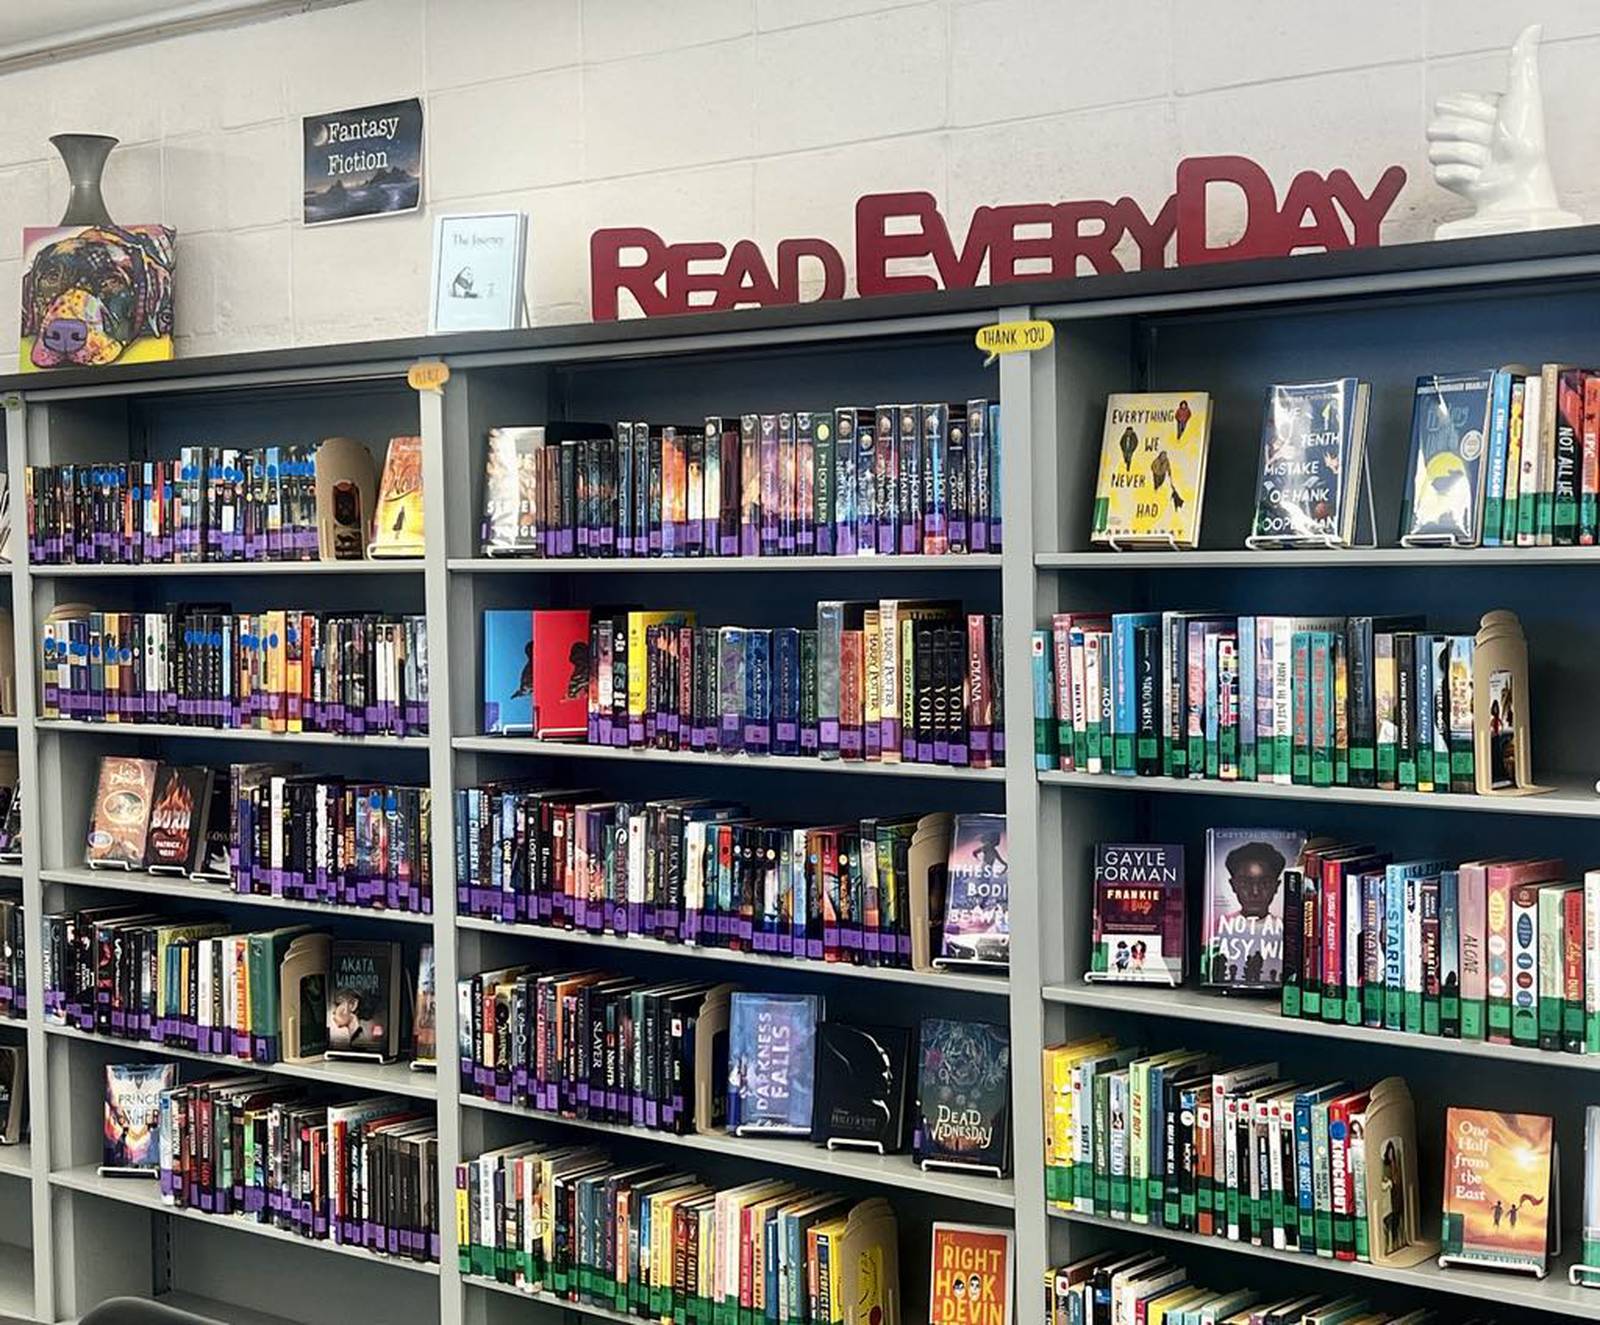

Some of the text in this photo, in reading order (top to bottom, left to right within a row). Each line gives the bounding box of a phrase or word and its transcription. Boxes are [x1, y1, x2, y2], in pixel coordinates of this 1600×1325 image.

[327, 116, 400, 144] Fantasy
[327, 150, 388, 176] Fiction
[590, 155, 1407, 322] READ EVERY DAY
[981, 324, 1046, 347] THANK YOU
[1112, 408, 1174, 424] EVERYTHING
[1144, 436, 1159, 452] WE
[1300, 432, 1339, 447] TENTH
[1559, 427, 1573, 453] NOT
[1263, 460, 1320, 476] MISTAKE
[1558, 456, 1573, 478] ALL
[1111, 473, 1146, 488] NEVER
[1291, 488, 1330, 502] HANK
[1136, 502, 1159, 518] HAD
[869, 633, 880, 711] HARRY POTTER
[884, 627, 895, 707] HARRY POTTER
[971, 660, 981, 702] DIANA
[919, 686, 931, 735] YORK
[934, 686, 946, 734] YORK
[949, 685, 961, 735] YORK
[1102, 687, 1111, 717] MOO
[1142, 676, 1152, 731] MOONRISE
[152, 810, 192, 829] BURN
[469, 820, 478, 870] CHILDREN
[1105, 851, 1166, 866] GAYLE
[1096, 866, 1176, 882] FORMAN
[1107, 889, 1160, 900] FRANKIE
[1218, 915, 1260, 935] NOT
[1210, 936, 1254, 959] EASY
[1367, 930, 1377, 962] NATE
[1427, 932, 1435, 976] FRANKIE
[1464, 934, 1479, 974] ALONE
[341, 958, 375, 974] AKATA
[336, 974, 380, 993] WARRIOR
[593, 1020, 603, 1068] SLAYER
[756, 1012, 773, 1110] DARKNESS
[772, 1026, 790, 1099] FALLS
[937, 1104, 981, 1124] DEAD
[1133, 1093, 1141, 1139] FAT BOY
[928, 1120, 993, 1148] WEDNESDAY
[1459, 1120, 1489, 1138] One
[1458, 1137, 1489, 1151] Half
[1454, 1152, 1489, 1169] from
[1332, 1139, 1346, 1215] KNOCKOUT
[1461, 1171, 1482, 1184] the
[1455, 1185, 1485, 1201] East
[937, 1233, 956, 1245] THE
[942, 1245, 1002, 1273] RIGHT
[820, 1269, 829, 1307] PERFECT
[936, 1269, 997, 1302] HOOK
[942, 1297, 1003, 1325] DEVIN
